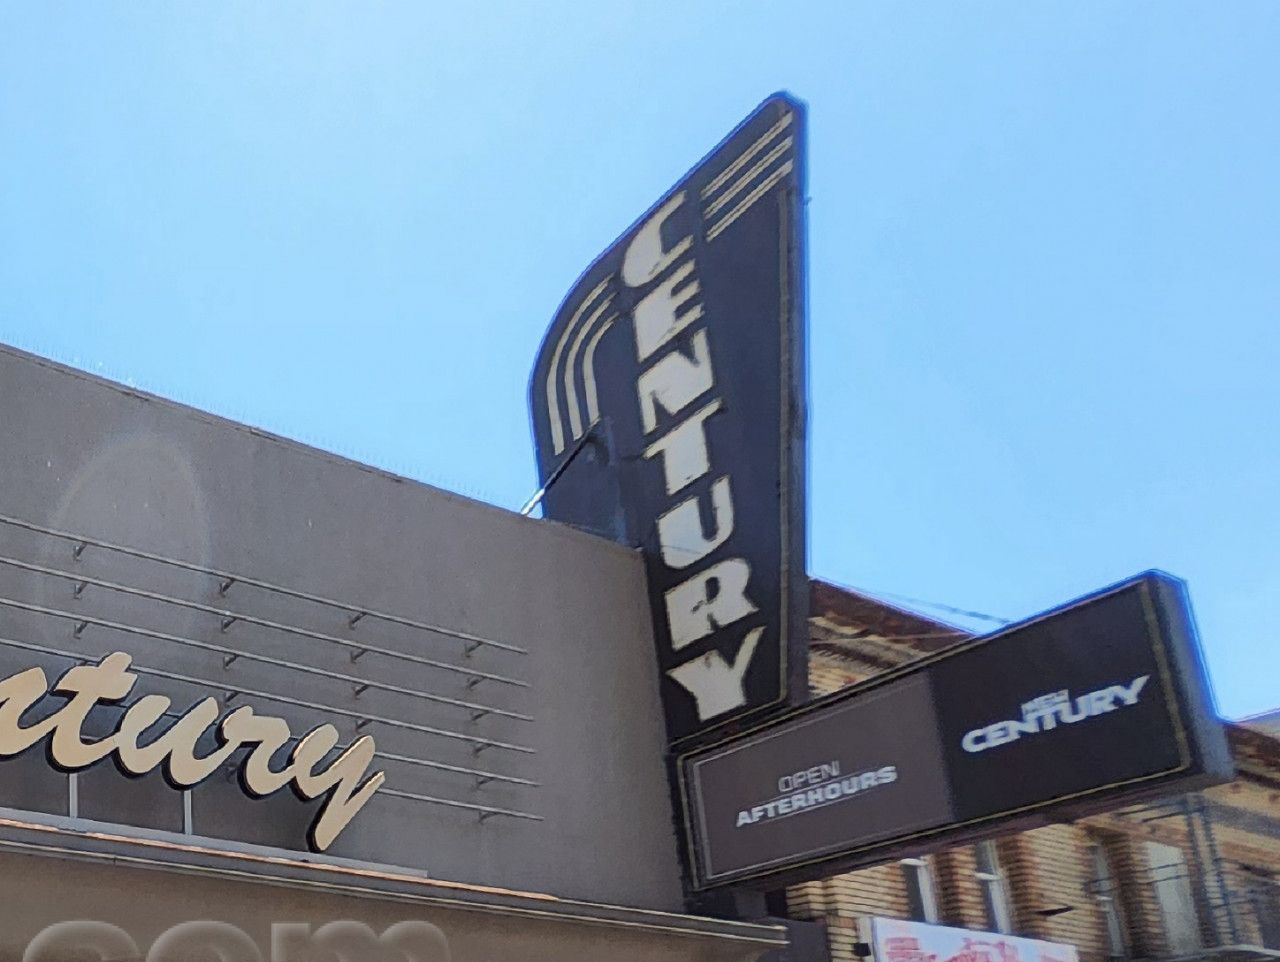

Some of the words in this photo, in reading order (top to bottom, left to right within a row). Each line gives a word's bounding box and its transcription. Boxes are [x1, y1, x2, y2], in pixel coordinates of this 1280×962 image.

[622, 190, 767, 722] CENTURY
[961, 675, 1151, 753] CENTURY
[736, 766, 898, 828] AFTERHOURS
[778, 760, 840, 793] OPEN
